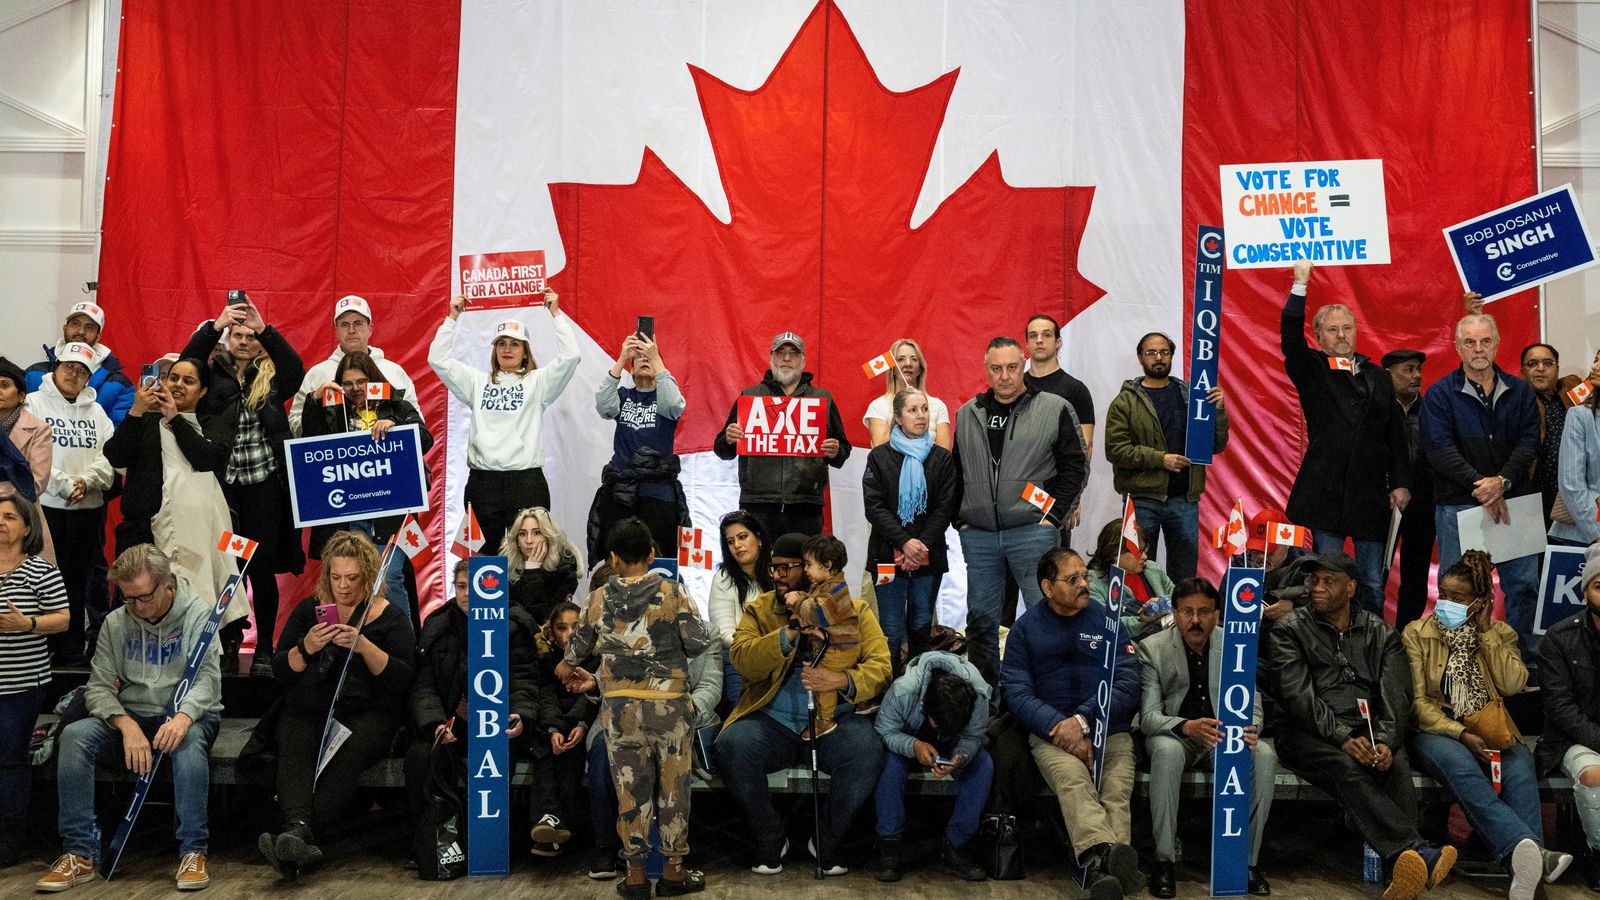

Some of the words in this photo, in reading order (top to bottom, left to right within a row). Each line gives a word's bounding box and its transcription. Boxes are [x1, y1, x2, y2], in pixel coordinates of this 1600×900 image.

[1236, 170, 1292, 190] VOTE
[1304, 169, 1340, 188] FOR
[1239, 192, 1318, 216] CHANGE
[1279, 217, 1333, 239] VOTE
[1464, 227, 1494, 246] BOB
[1495, 202, 1561, 234] DOSANJH
[1485, 223, 1555, 260] SINGH
[1233, 239, 1367, 264] CONSERVATIVE
[1198, 262, 1221, 274] TIM
[1516, 252, 1558, 270] Conservative
[462, 266, 509, 282] CANADA
[511, 265, 543, 279] FIRST
[466, 284, 486, 297] FOR
[489, 284, 496, 296] A
[498, 280, 542, 295] CHANGE
[45, 417, 65, 428] DO
[69, 420, 95, 429] YOU
[745, 397, 820, 434] AXE
[53, 428, 81, 436] ELIEVE
[304, 450, 334, 463] BOB
[338, 440, 404, 459] DOSANJH
[744, 434, 779, 452] THE
[784, 435, 819, 454] TAX
[322, 458, 392, 482] SINGH
[348, 489, 392, 500] Conservative
[472, 608, 505, 620] TIM
[204, 621, 218, 634] TIM
[1105, 616, 1116, 633] TIM
[1228, 621, 1257, 634] TIM
[440, 855, 465, 864] adidas
